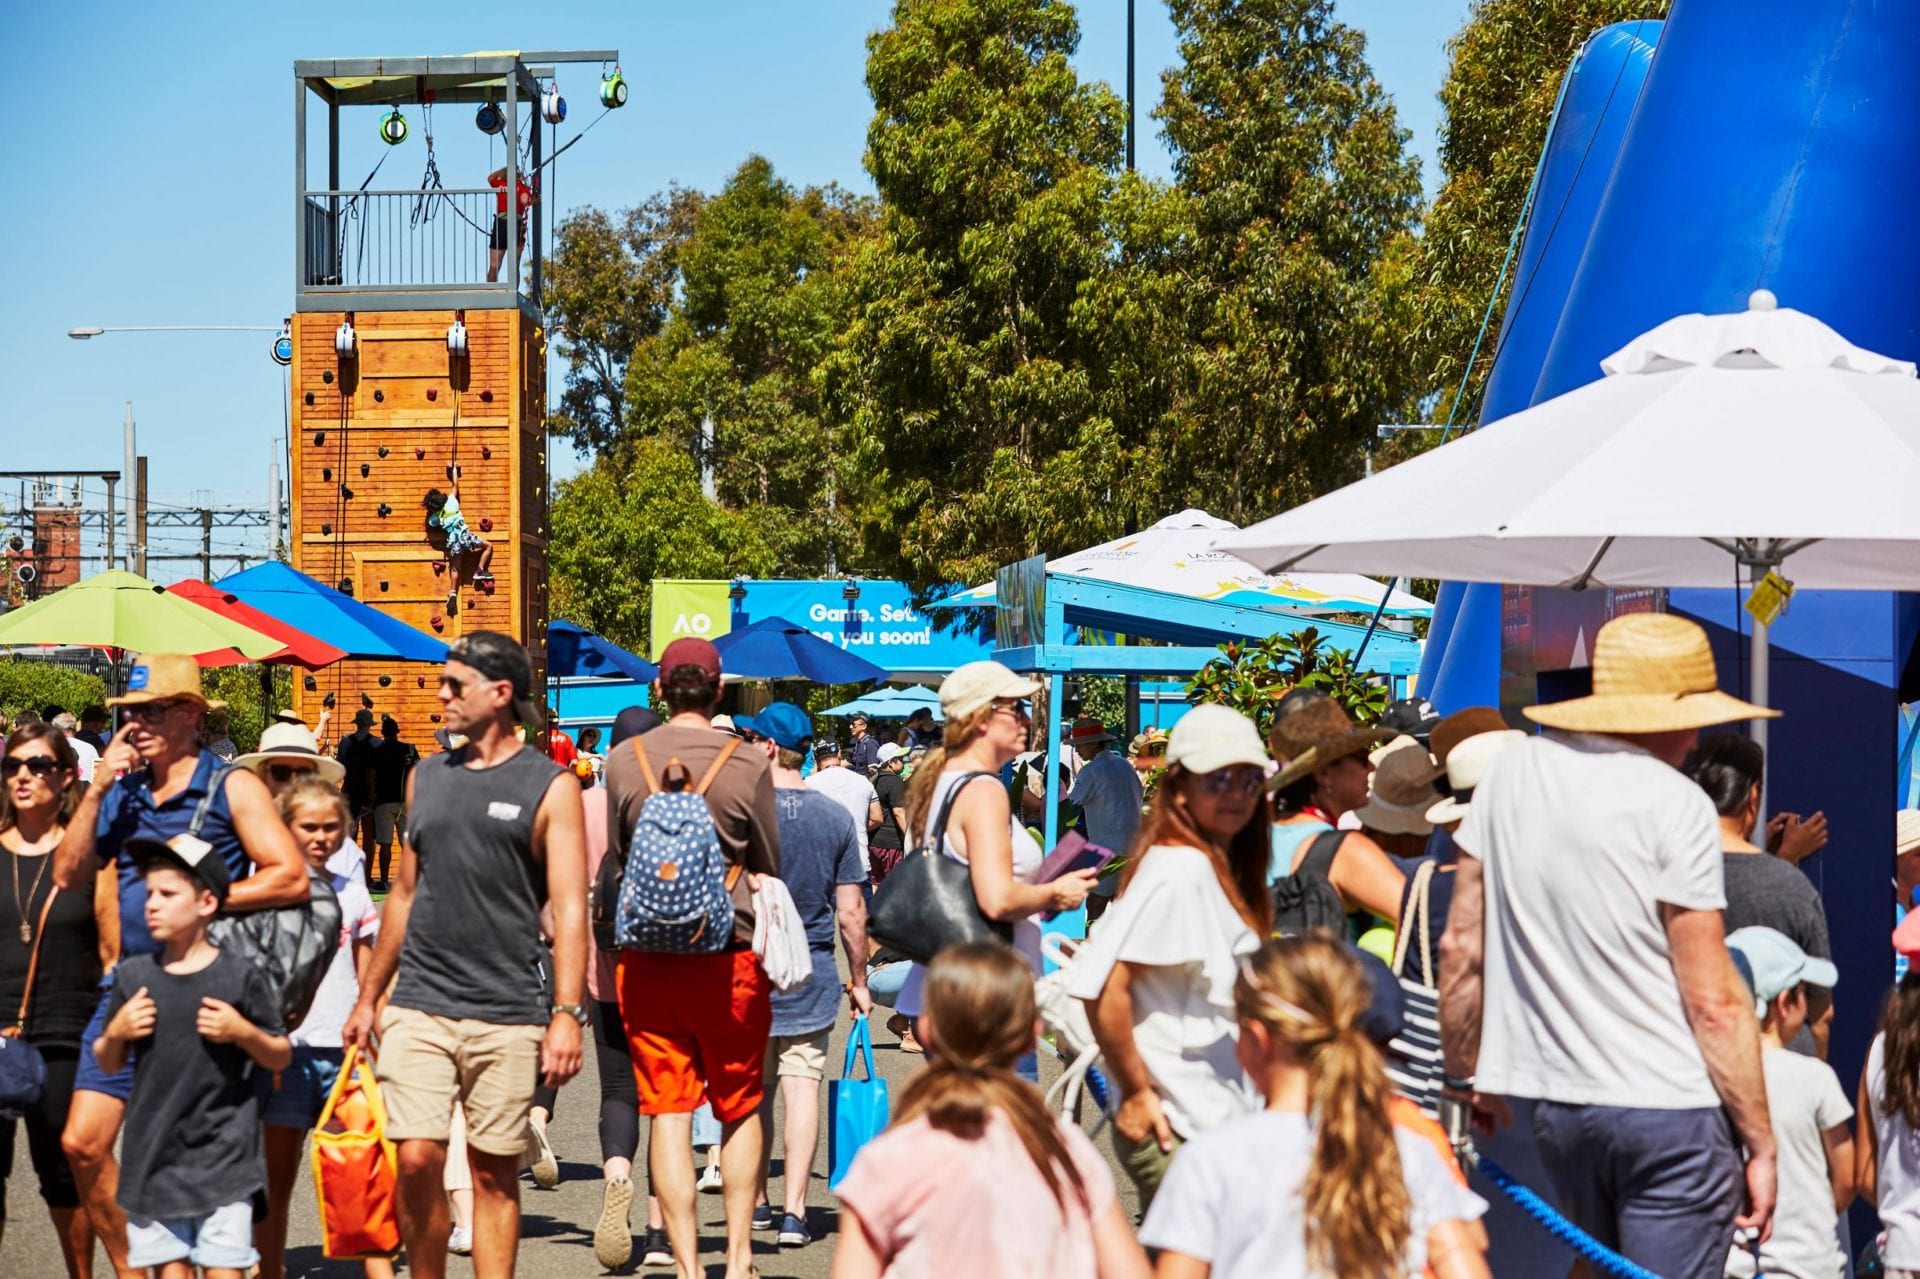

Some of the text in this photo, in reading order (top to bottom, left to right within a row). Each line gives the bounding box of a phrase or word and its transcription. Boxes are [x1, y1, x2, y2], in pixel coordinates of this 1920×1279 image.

[809, 603, 918, 622] Game. Set.
[672, 613, 711, 634] AO
[839, 631, 874, 650] you
[879, 626, 931, 645] soon!
